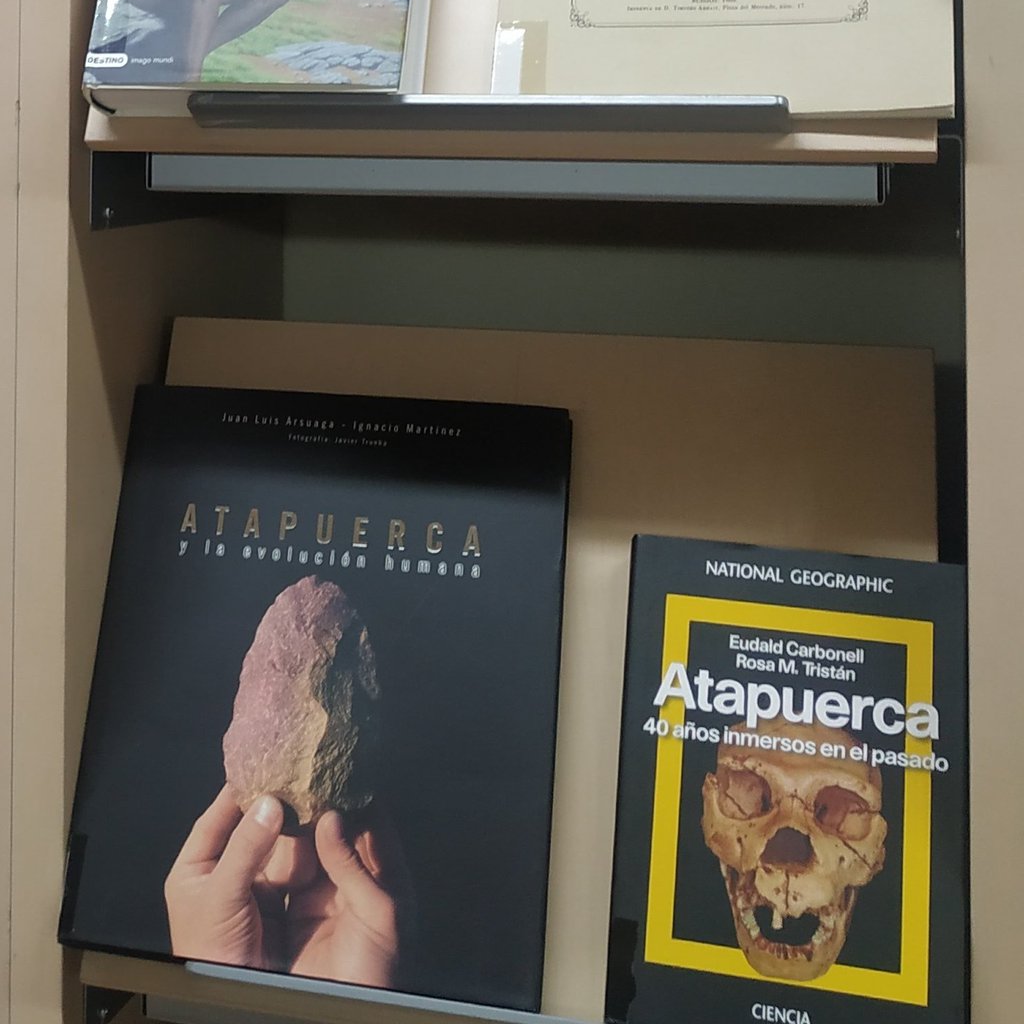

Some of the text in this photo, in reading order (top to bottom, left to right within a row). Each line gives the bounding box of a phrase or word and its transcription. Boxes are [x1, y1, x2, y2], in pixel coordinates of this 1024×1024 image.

[152, 56, 174, 64] mundi
[222, 413, 249, 424] Juan
[254, 414, 279, 426] Luis
[285, 416, 335, 430] Arsuaga
[352, 420, 399, 433] Ignacio
[180, 502, 481, 557] ATAPUERCA
[178, 538, 481, 579] y la evolución humana
[706, 560, 894, 594] NATIONAL GEOGRAPHIC
[729, 634, 865, 664] Eudald Carbonell
[735, 654, 856, 682] Rosa M. Tristán
[652, 662, 940, 739] Atapuerca
[642, 716, 950, 773] 40 años inmersos en el pasado
[751, 1003, 811, 1024] CIENCIA
